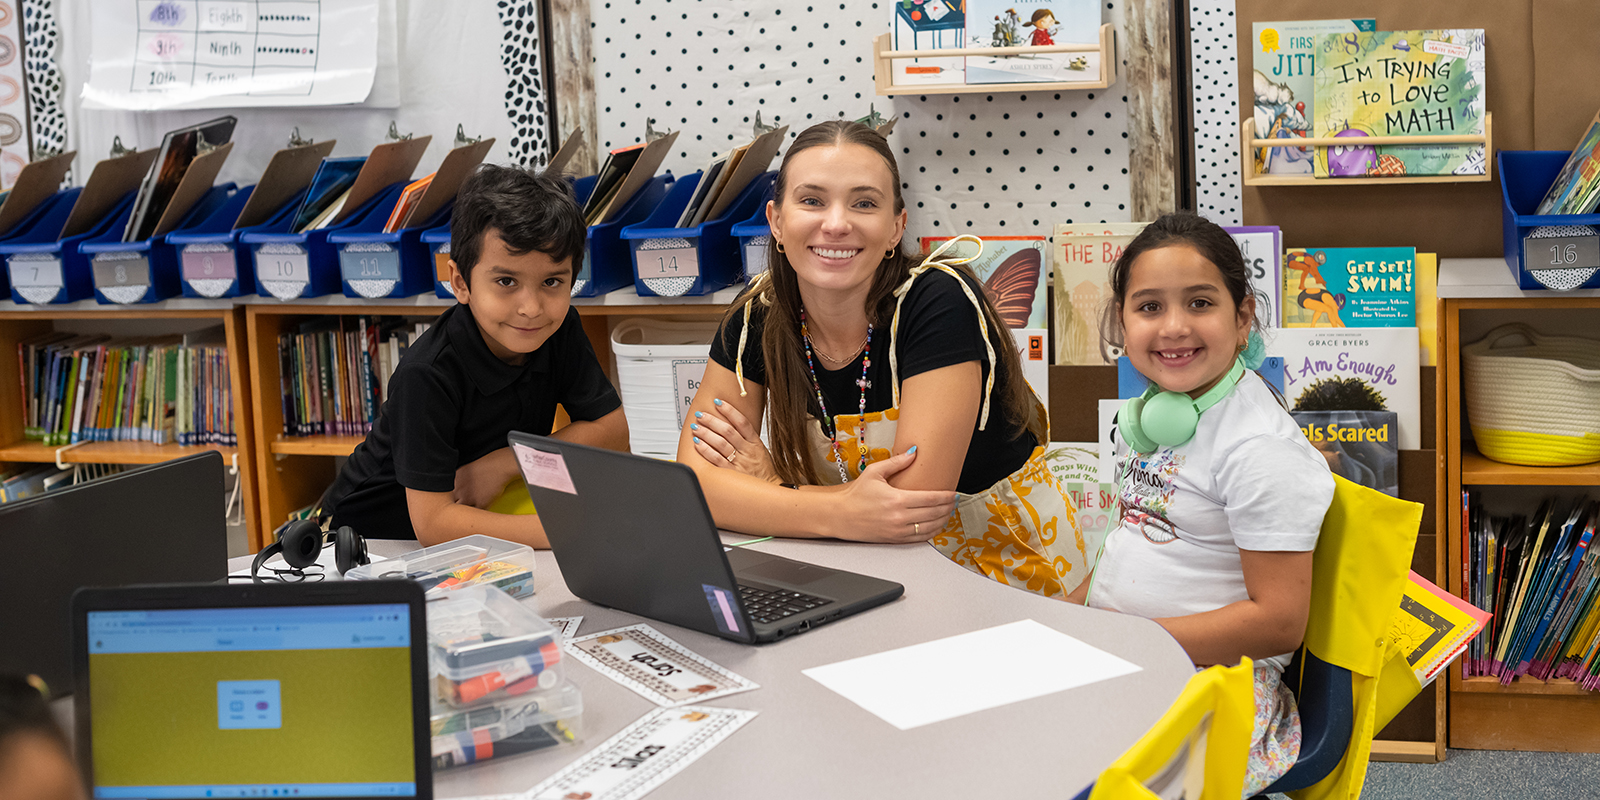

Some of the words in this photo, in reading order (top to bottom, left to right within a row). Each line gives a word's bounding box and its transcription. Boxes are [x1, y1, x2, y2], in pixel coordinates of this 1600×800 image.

[156, 6, 179, 21] 8th
[208, 7, 243, 27] Eighth
[156, 41, 177, 55] 9th
[210, 42, 242, 56] Ninth
[149, 71, 176, 85] 10th
[1377, 58, 1451, 82] TRYING
[1357, 90, 1381, 105] to
[1384, 107, 1454, 134] MATH
[975, 245, 1008, 277] Alphabet
[1061, 243, 1093, 264] THE
[1102, 241, 1129, 264] BA
[1550, 244, 1577, 265] 16
[202, 256, 215, 275] 9
[276, 261, 293, 276] 10
[359, 257, 382, 277] 11
[657, 255, 679, 274] 14
[30, 267, 39, 282] 7
[113, 265, 128, 284] 8
[1346, 273, 1412, 293] SWIM!
[1308, 339, 1338, 347] GRACE
[1342, 339, 1369, 347] BYERS
[1284, 364, 1297, 386] I
[1298, 356, 1333, 378] Am
[1336, 352, 1397, 386] Enough
[1326, 423, 1388, 443] Scared
[1051, 464, 1074, 472] Days
[1076, 463, 1098, 474] With
[1064, 472, 1081, 480] and
[1070, 490, 1094, 509] THE
[1543, 594, 1561, 622] ANIMALS
[629, 652, 683, 677] Sarah
